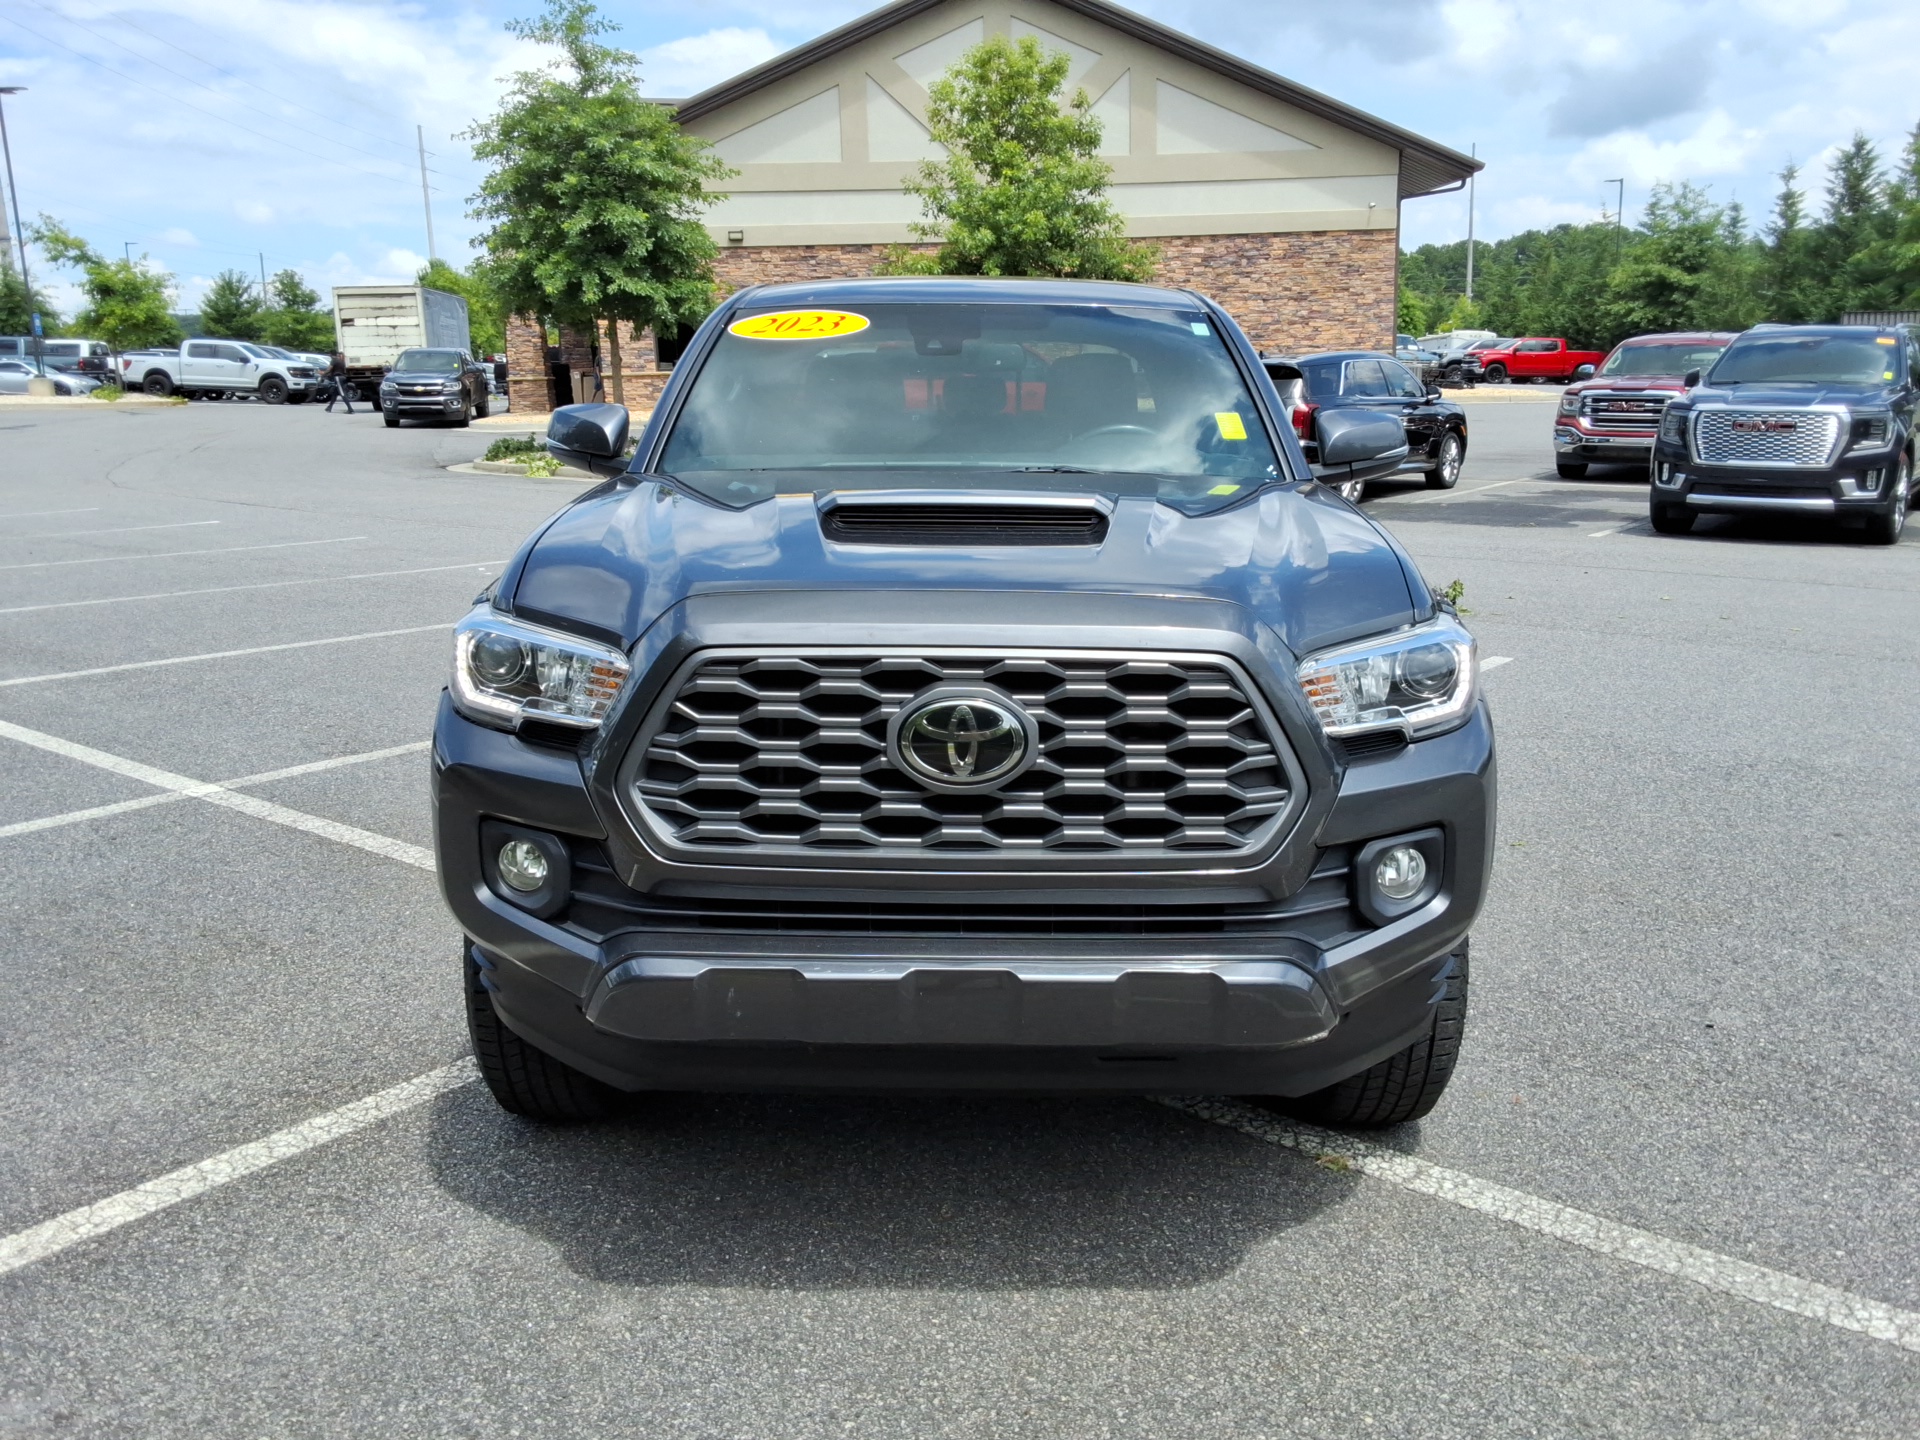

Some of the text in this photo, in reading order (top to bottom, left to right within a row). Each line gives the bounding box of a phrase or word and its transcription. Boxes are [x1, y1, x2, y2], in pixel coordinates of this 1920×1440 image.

[751, 315, 847, 334] 2023
[1607, 401, 1645, 411] GMC
[1733, 420, 1796, 432] GMC
